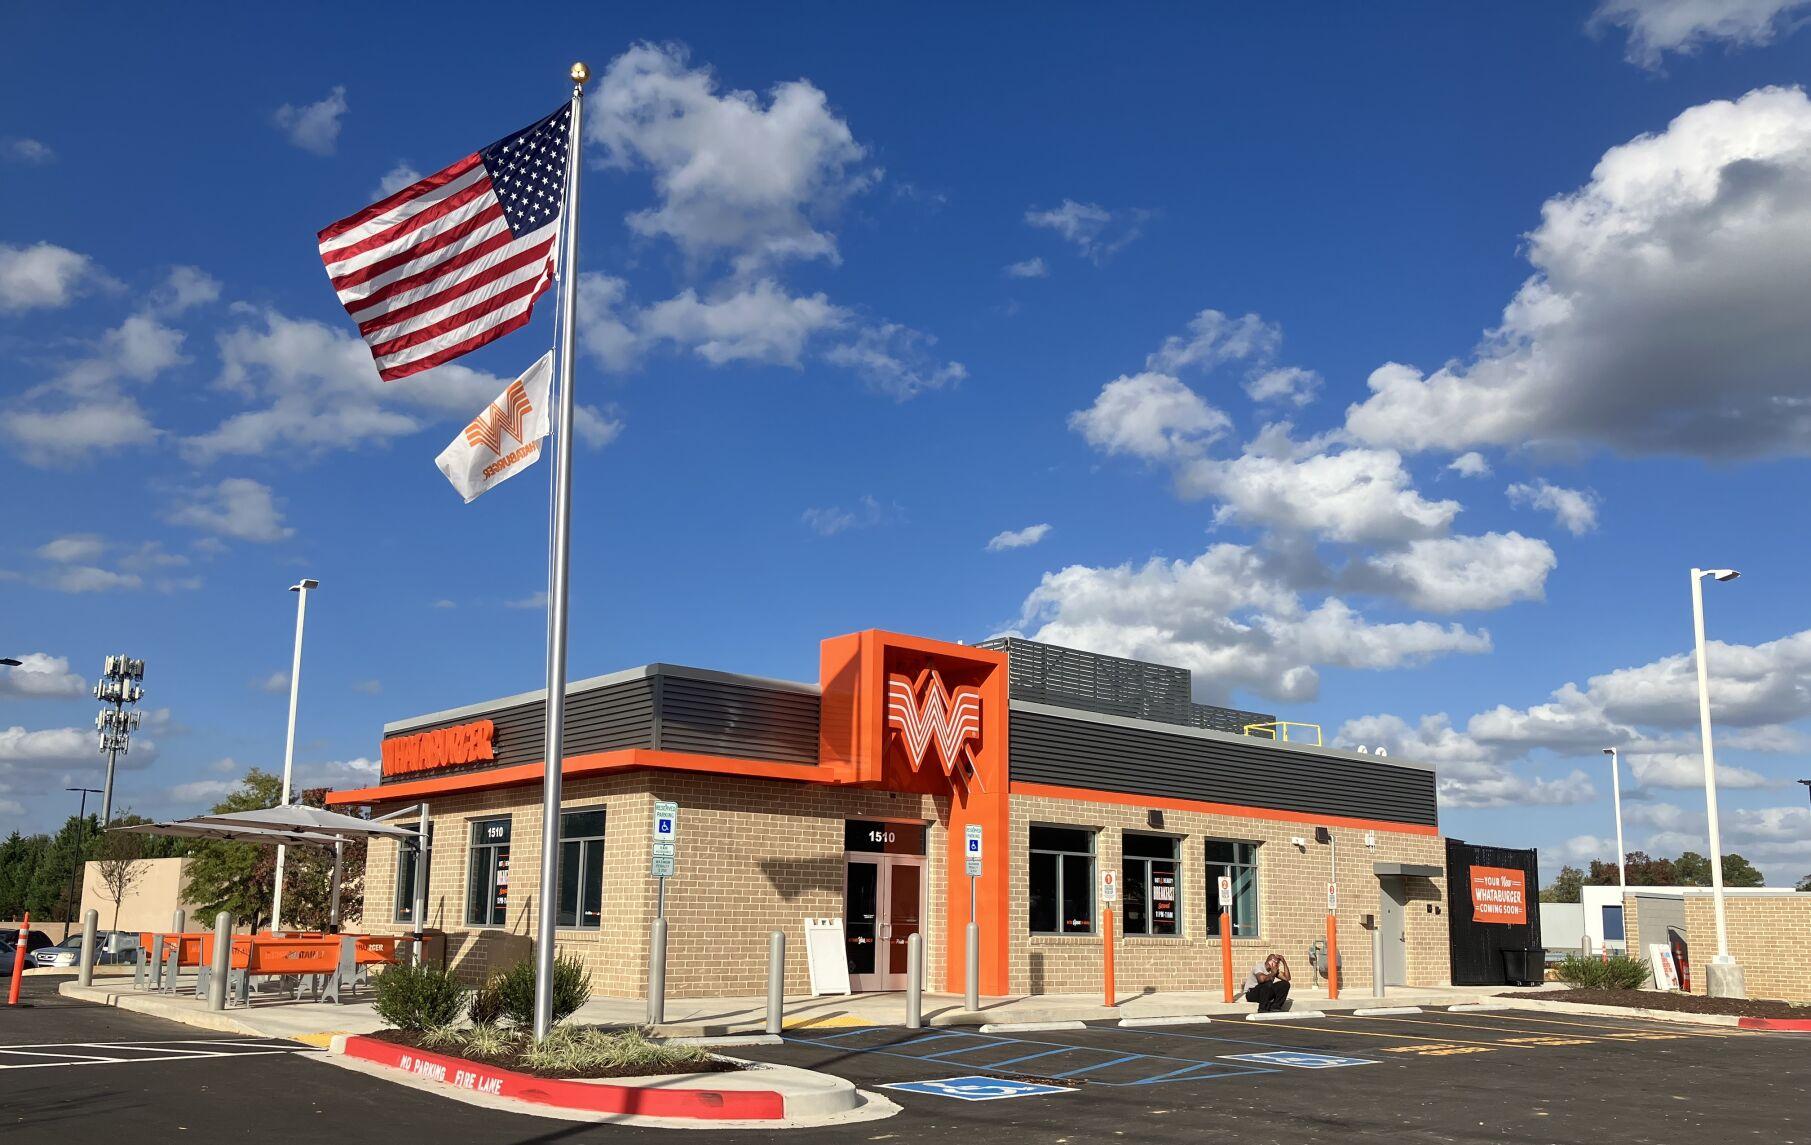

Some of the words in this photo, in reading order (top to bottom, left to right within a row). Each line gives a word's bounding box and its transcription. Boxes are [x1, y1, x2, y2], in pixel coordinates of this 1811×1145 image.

[381, 719, 494, 776] WHATABURGER
[488, 827, 503, 838] 1510
[869, 831, 895, 843] 1510
[1484, 876, 1500, 886] YOUR
[1475, 888, 1522, 903] WHATABURGER
[1480, 904, 1502, 914] COMING
[1504, 905, 1519, 914] SOON
[400, 1054, 412, 1070] NO
[414, 1059, 446, 1081] PARKING
[455, 1070, 476, 1088] FIRE
[478, 1075, 503, 1094] LANE
